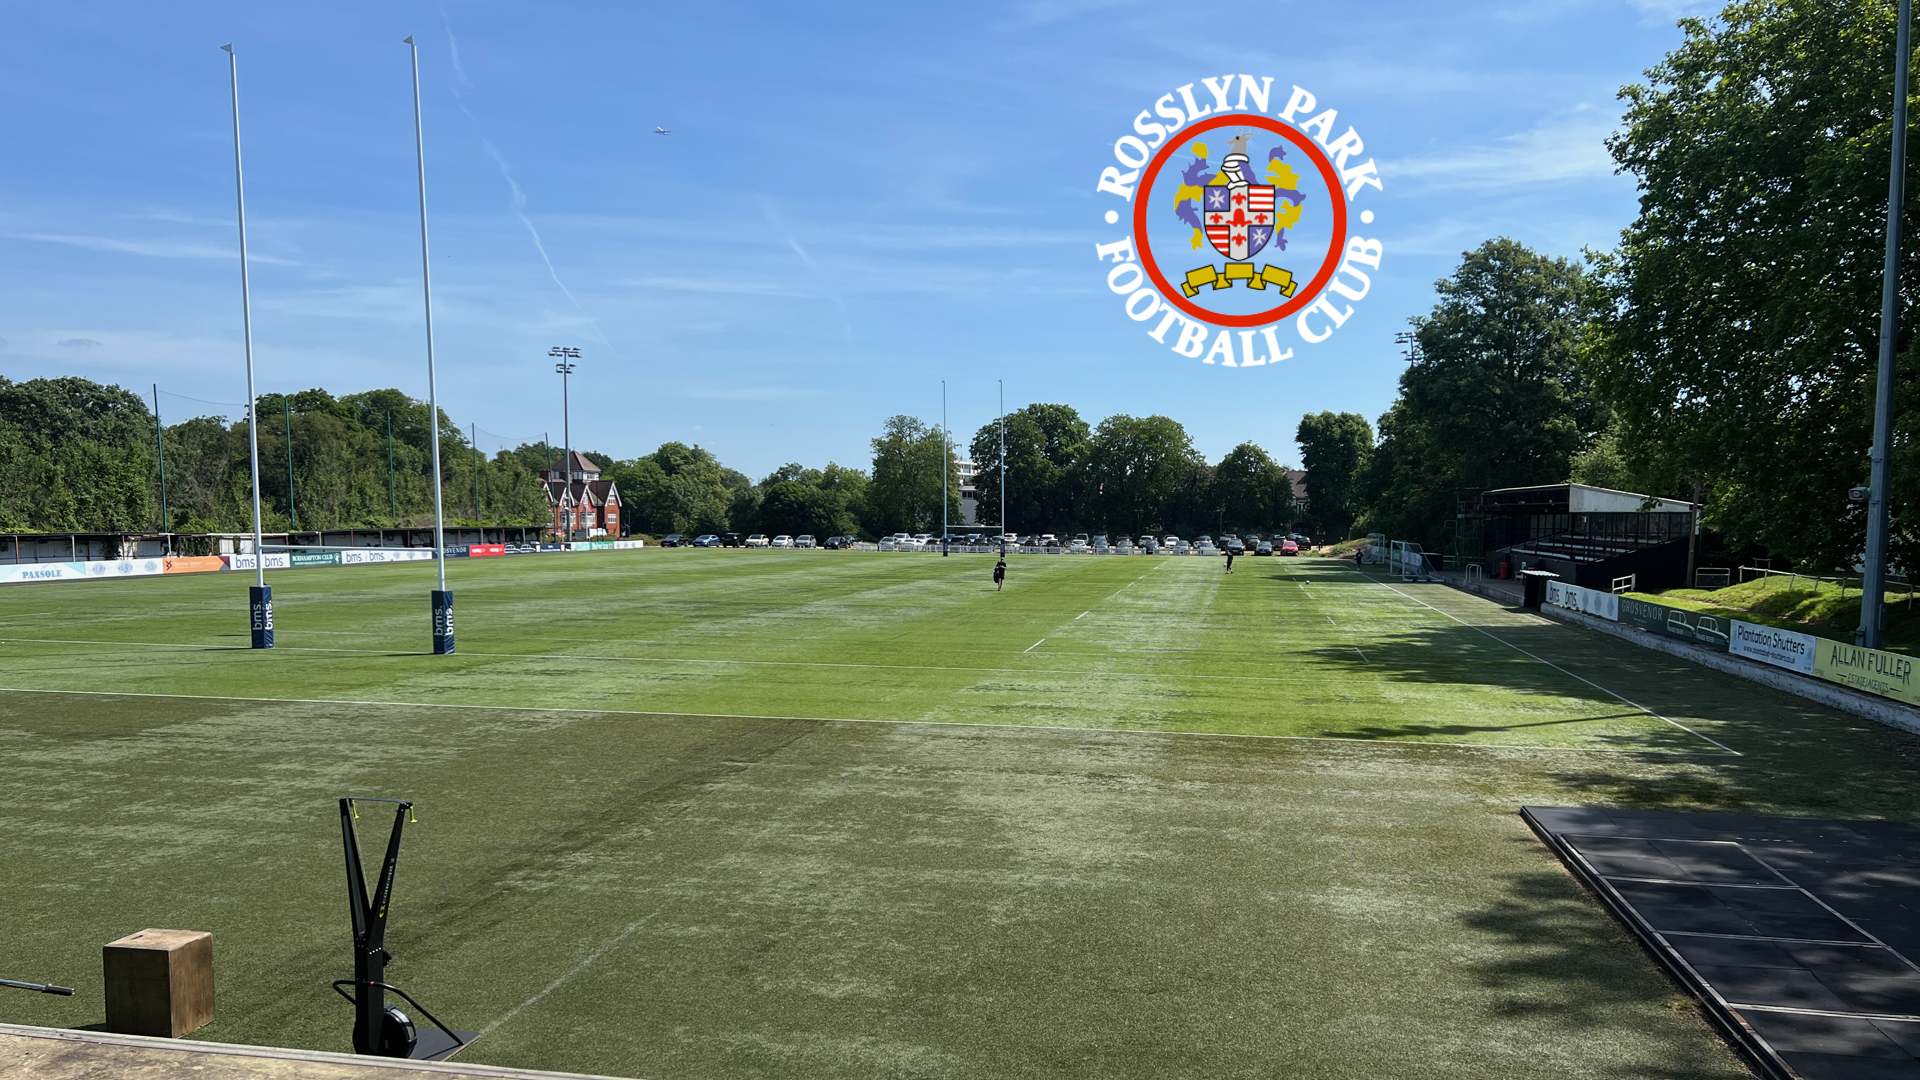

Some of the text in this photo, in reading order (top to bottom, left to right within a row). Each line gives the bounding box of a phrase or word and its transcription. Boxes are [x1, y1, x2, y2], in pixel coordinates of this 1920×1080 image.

[22, 570, 62, 579] PAXSOLE
[1621, 599, 1663, 621] GROSVENOR
[1737, 625, 1771, 647] Plantation
[1772, 632, 1805, 655] Shutters
[1830, 645, 1865, 670] ALLAN
[1867, 652, 1911, 686] FULLER
